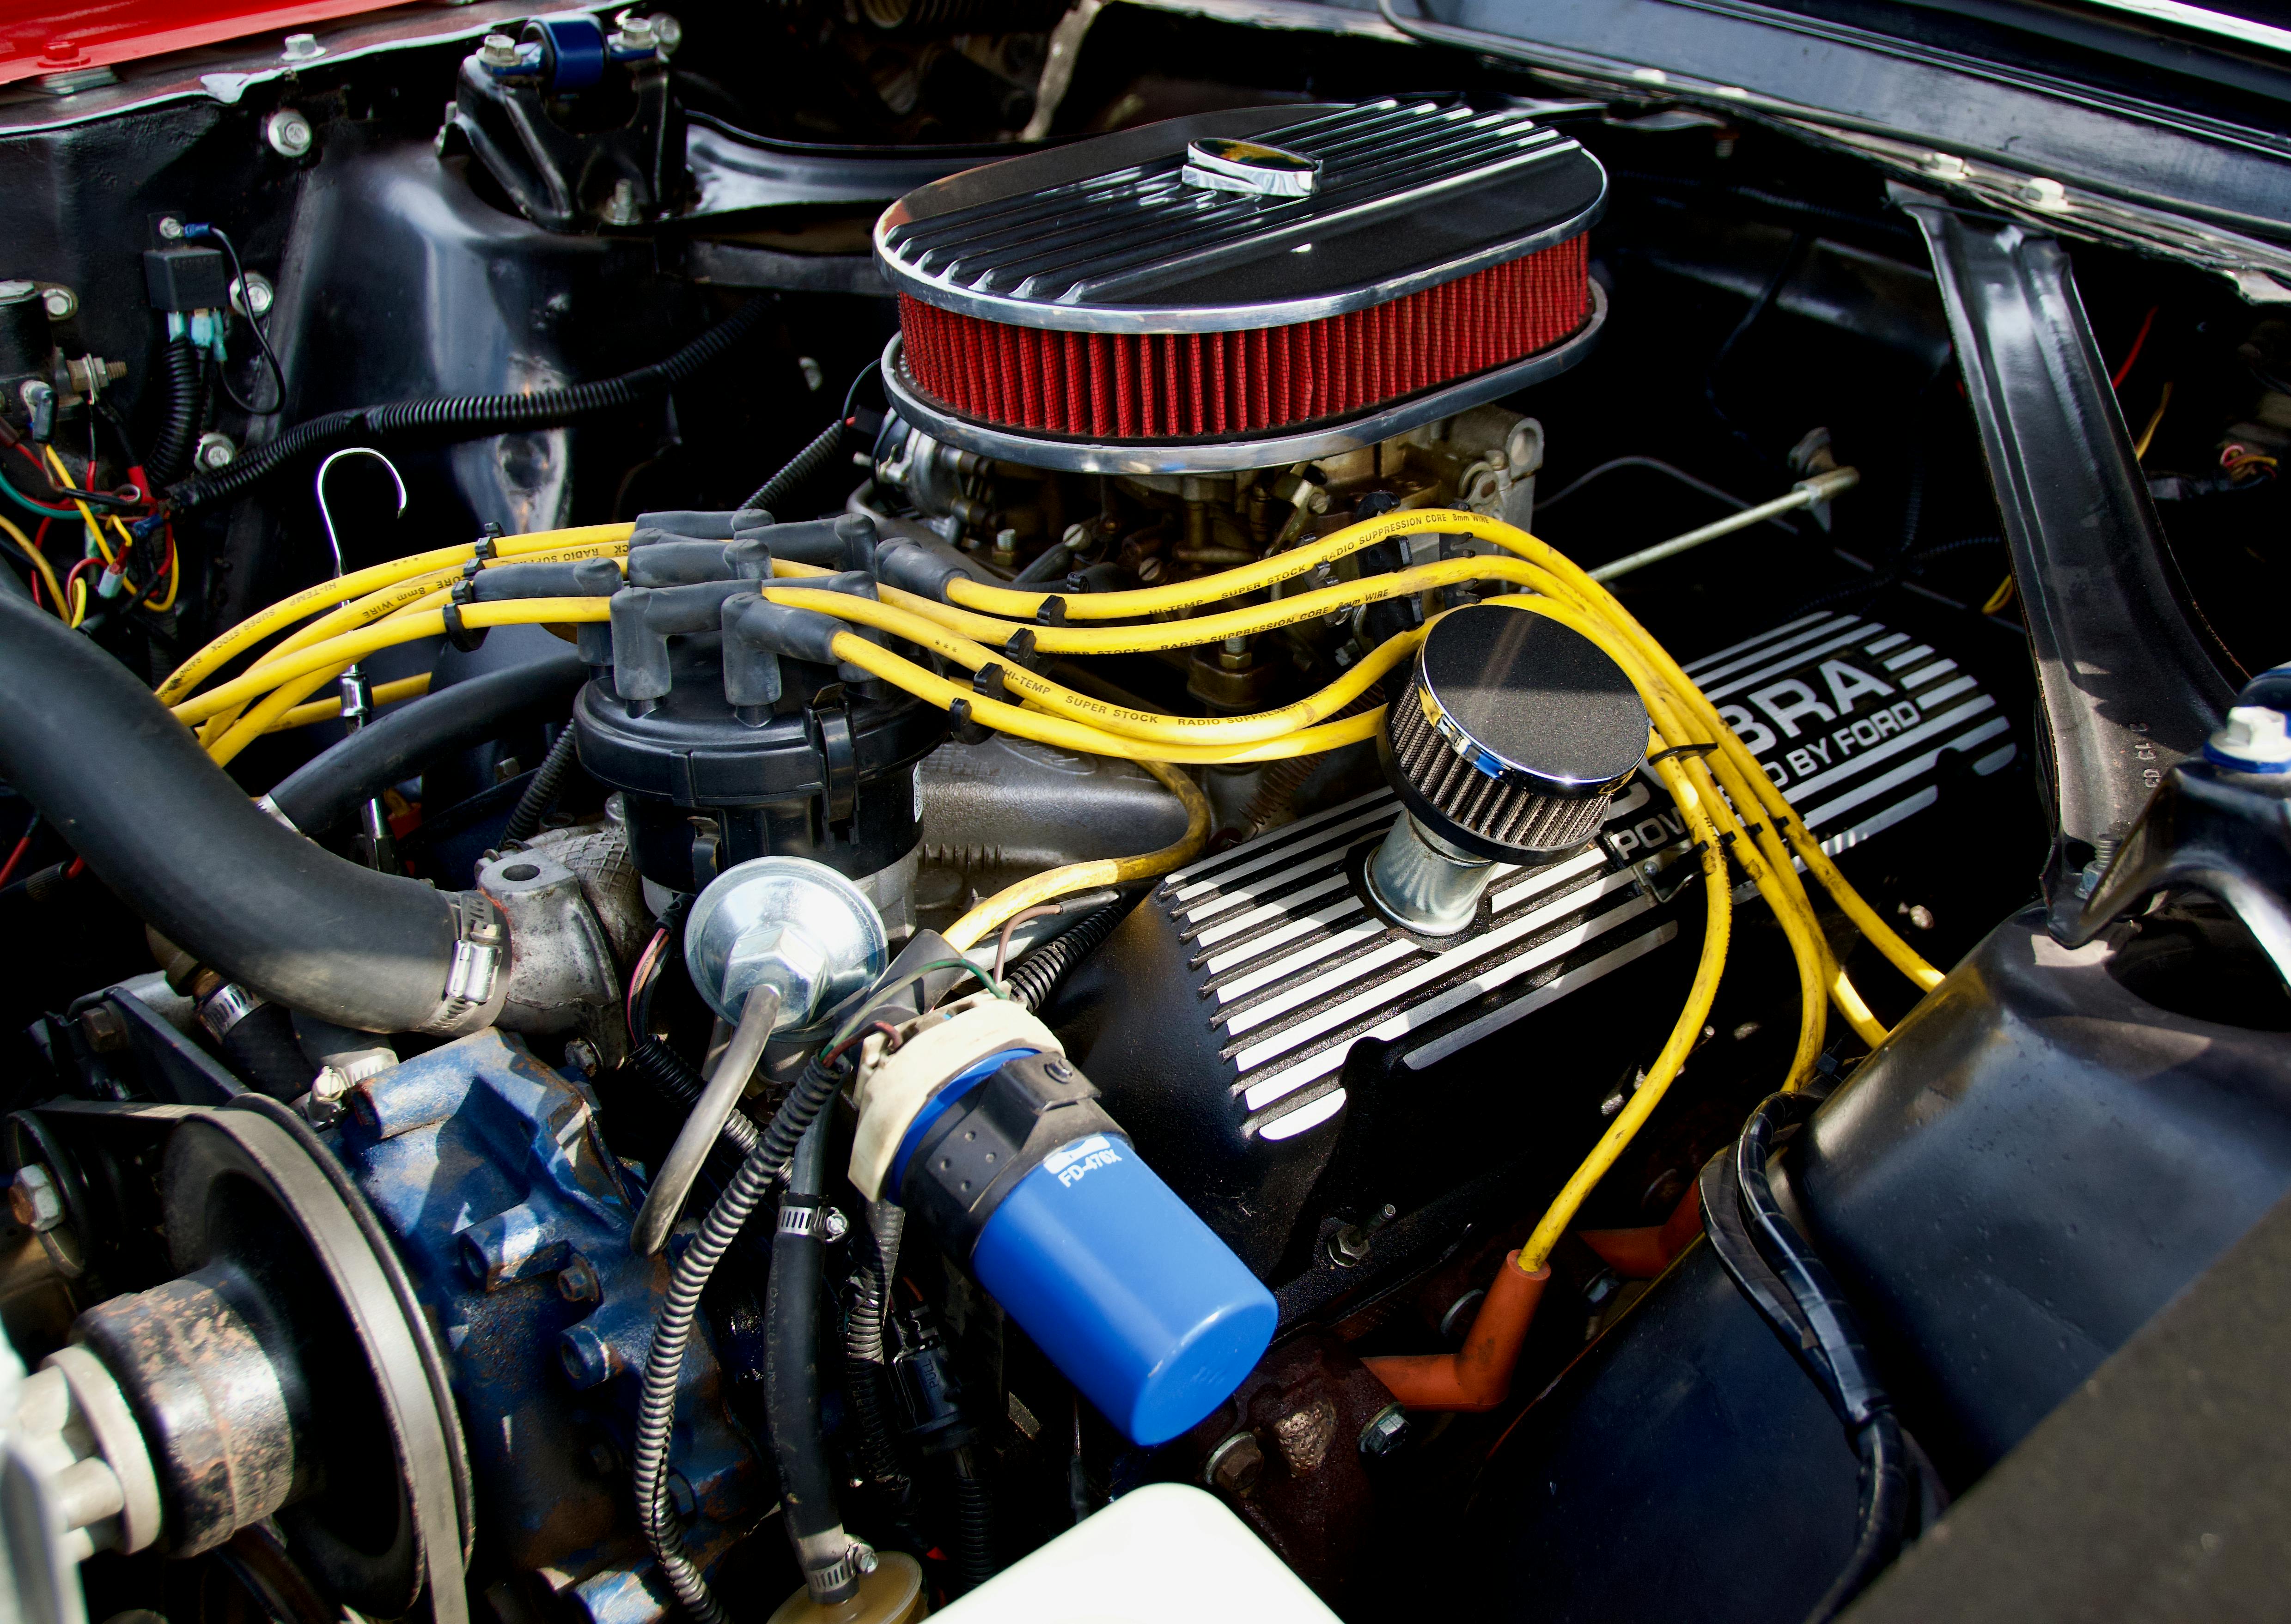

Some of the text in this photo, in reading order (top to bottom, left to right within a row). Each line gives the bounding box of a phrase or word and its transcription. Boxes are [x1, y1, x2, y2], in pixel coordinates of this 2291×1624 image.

[563, 548, 599, 561] RADIO
[1149, 599, 1203, 614] HI-TEMP
[1221, 581, 1261, 599] SUPER
[1267, 563, 1306, 584] STOCK
[1321, 541, 1355, 562] RADIO
[1359, 516, 1422, 545] SUPPRESSION
[1426, 513, 1447, 523] CORE
[1471, 514, 1490, 524] WIRE
[396, 586, 426, 602] 8mm
[436, 573, 467, 589] ORE
[179, 581, 337, 679] HI-TEMP SUPER STOCK RADIO
[361, 600, 394, 620] WIRE
[1160, 639, 1204, 650] RADIO
[1209, 616, 1295, 642] SUPPRESSION
[1299, 606, 1329, 620] CORE
[1365, 589, 1389, 602] WIRE
[1004, 669, 1051, 695] HI-TEMP
[1065, 695, 1108, 714] SUPER
[1112, 709, 1158, 724] STOCK
[1227, 701, 1304, 724] SUPPRESSION
[1785, 736, 1833, 777] BY
[1831, 700, 1922, 756] FORD
[922, 1358, 939, 1388] PULL
